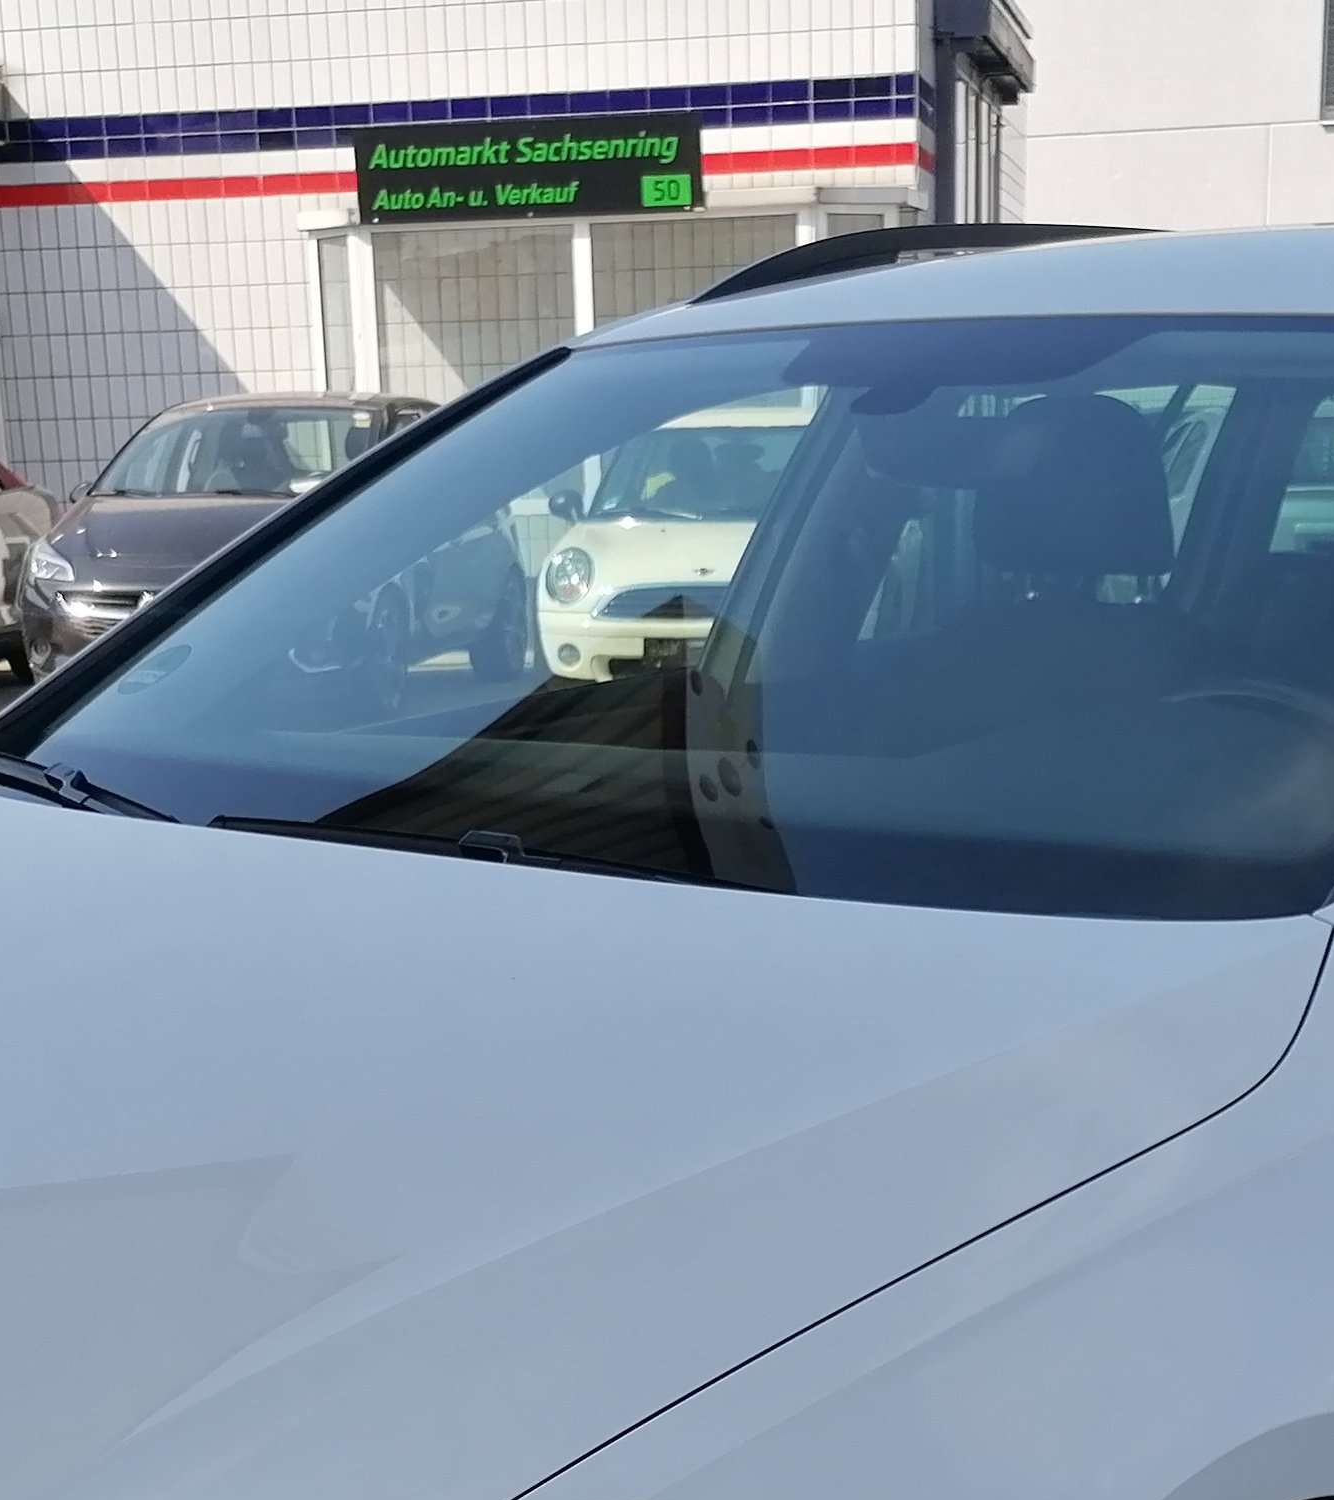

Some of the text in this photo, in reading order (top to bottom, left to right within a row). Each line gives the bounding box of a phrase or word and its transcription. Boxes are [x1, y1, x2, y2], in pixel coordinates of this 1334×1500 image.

[369, 130, 679, 170] Automarkt Sachsenring
[371, 180, 580, 211] Auto An- u. Verkauf
[652, 179, 680, 201] 50
